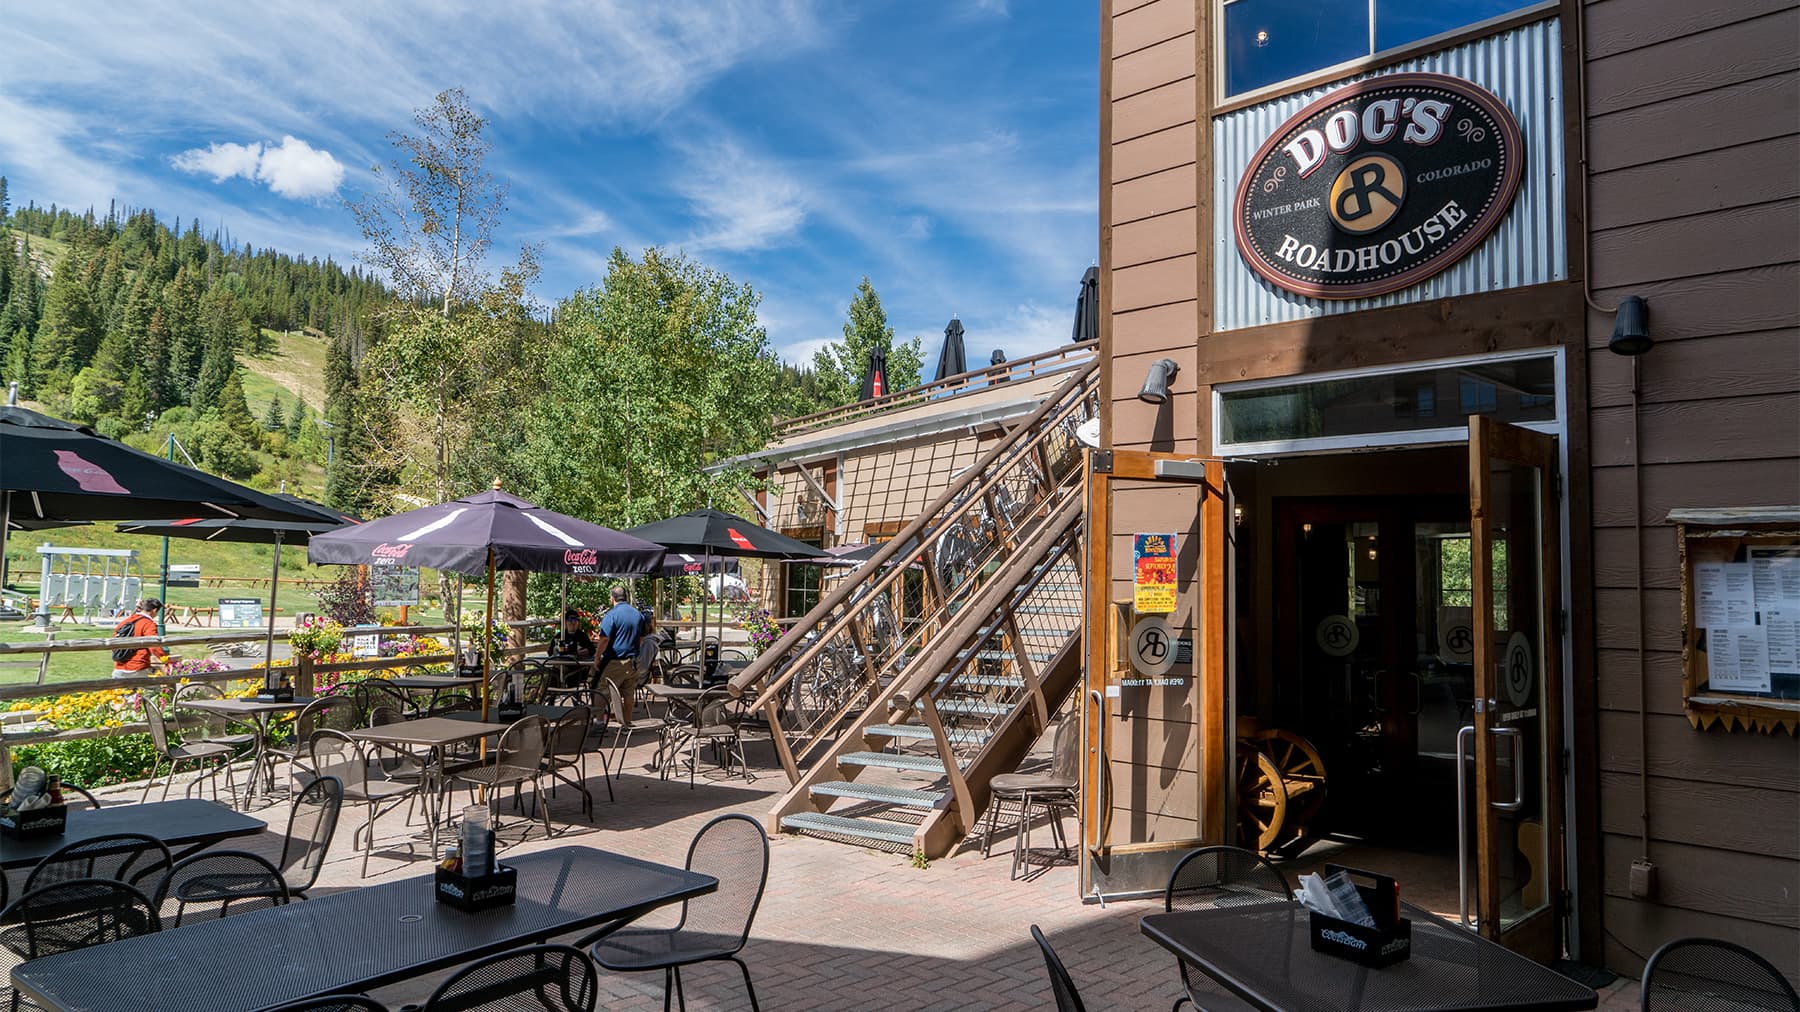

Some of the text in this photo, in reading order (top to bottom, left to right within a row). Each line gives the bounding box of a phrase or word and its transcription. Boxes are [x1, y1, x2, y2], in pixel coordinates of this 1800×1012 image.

[1282, 97, 1454, 180] DOC'S
[1416, 157, 1492, 184] COLORADO
[1252, 197, 1321, 221] WINTER PARK
[1274, 200, 1468, 273] ROADHOUSE
